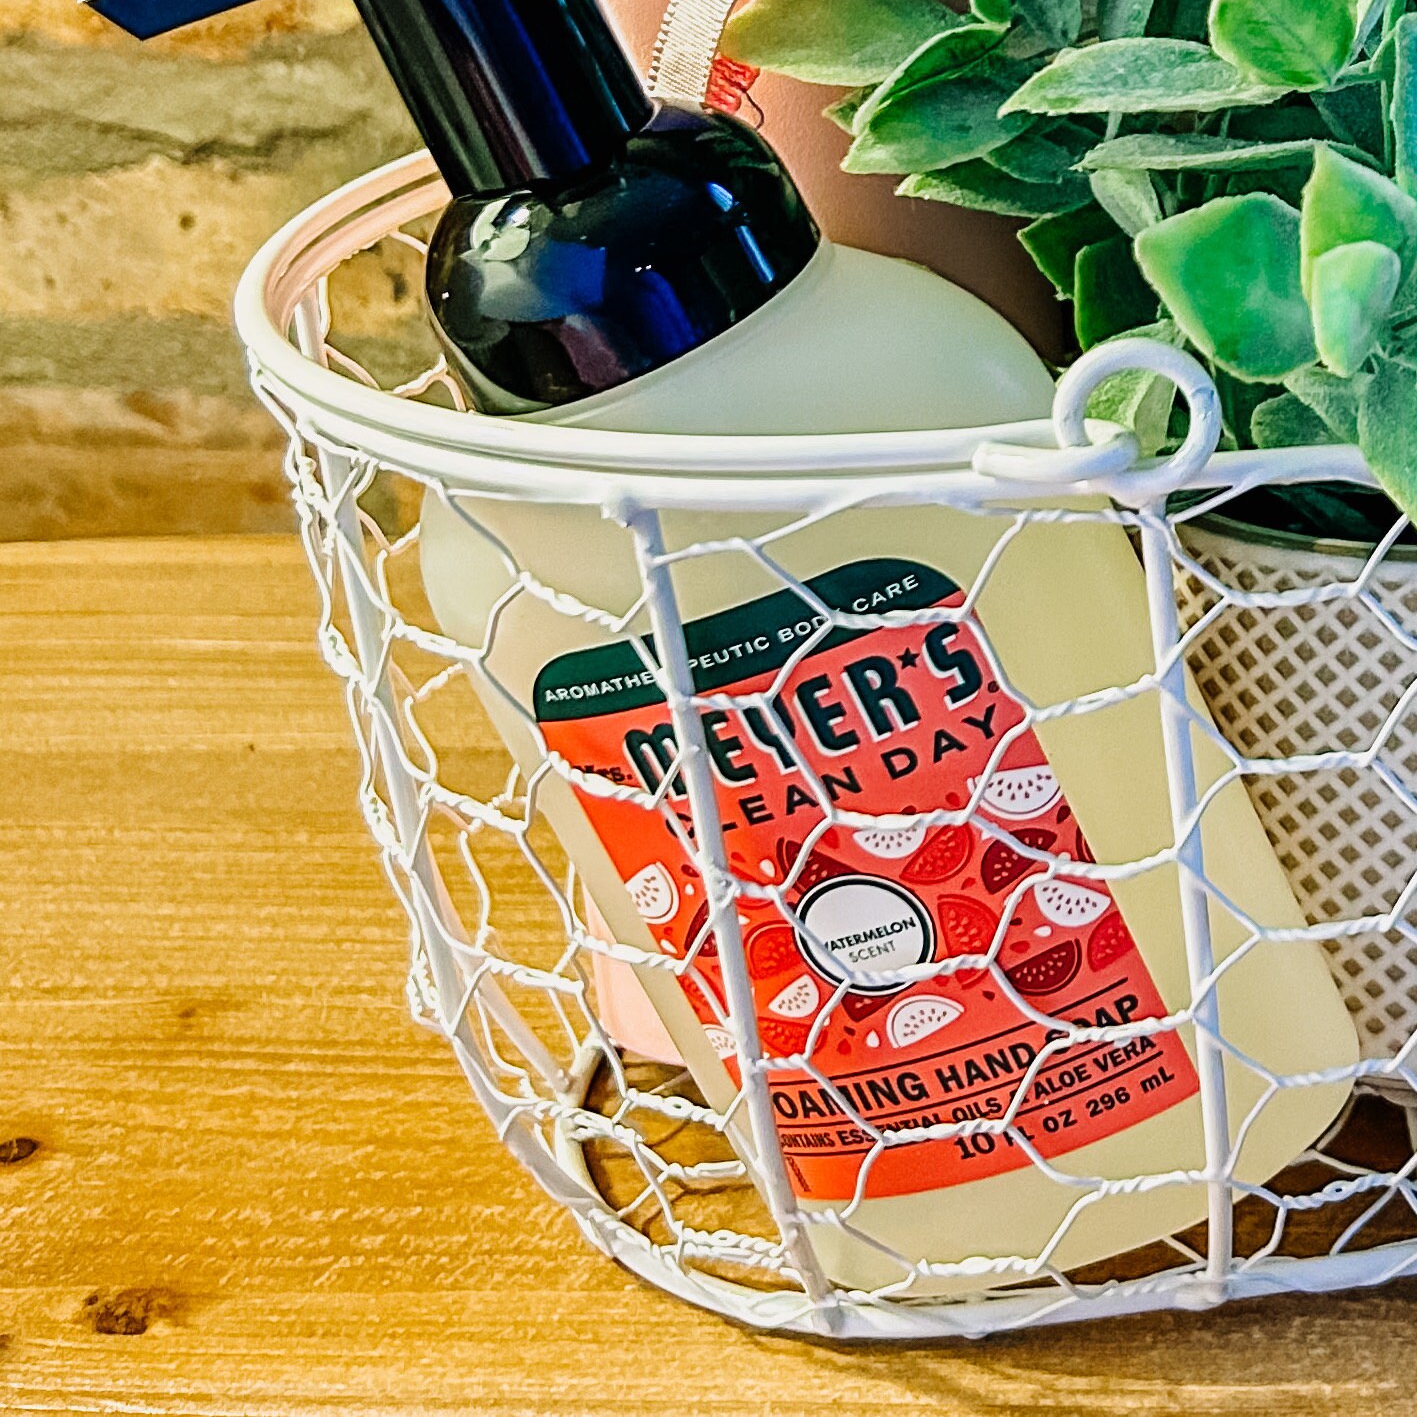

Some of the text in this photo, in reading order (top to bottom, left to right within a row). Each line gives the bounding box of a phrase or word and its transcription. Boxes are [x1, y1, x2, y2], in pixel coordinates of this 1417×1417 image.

[851, 573, 920, 614] CARE
[880, 702, 997, 781] DAY
[825, 916, 917, 952] ATERMELON
[848, 940, 897, 963] SCENT
[771, 1071, 931, 1120] OAMING
[935, 1041, 1037, 1094] HAND
[952, 1096, 1003, 1124] OILS
[1034, 1065, 1093, 1101] ALOE
[953, 1131, 996, 1160] 10
[1042, 1109, 1079, 1135] OZ
[1085, 1085, 1132, 1119] 296
[1139, 1065, 1176, 1094] mL
